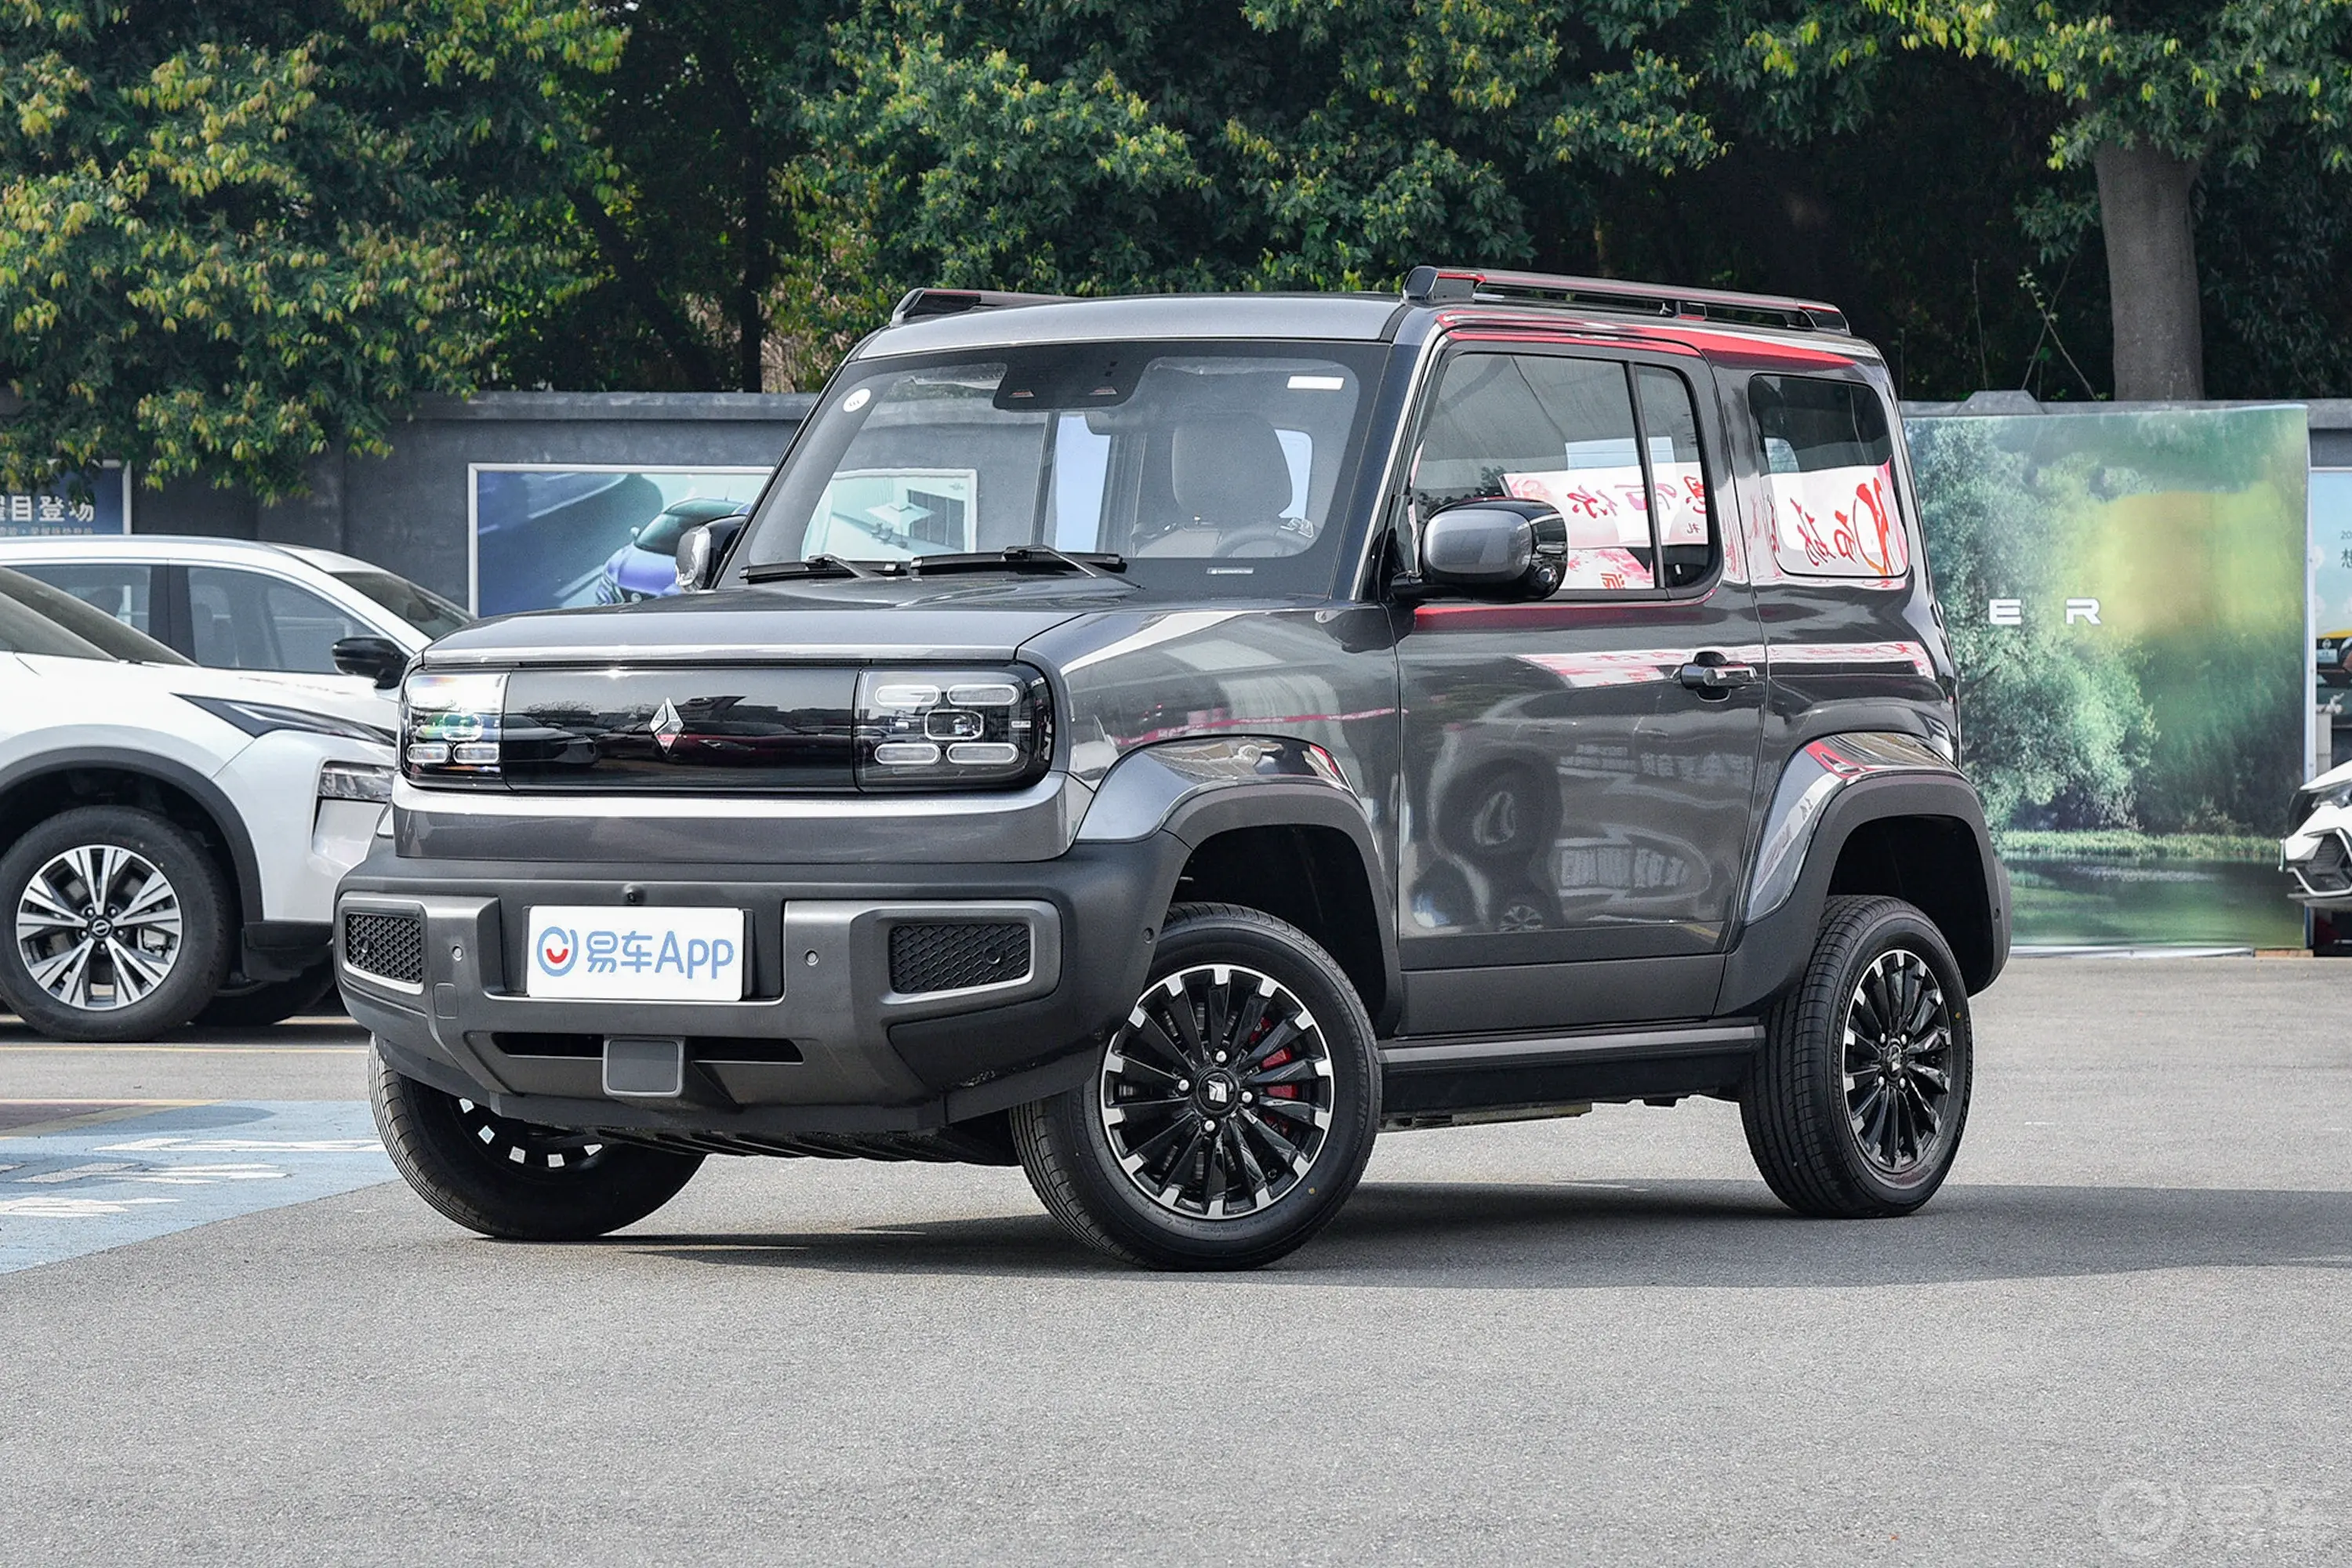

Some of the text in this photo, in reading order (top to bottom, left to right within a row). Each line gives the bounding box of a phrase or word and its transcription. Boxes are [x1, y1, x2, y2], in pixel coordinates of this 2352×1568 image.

[0, 495, 94, 522] 目登场
[586, 930, 734, 979] 易车App
